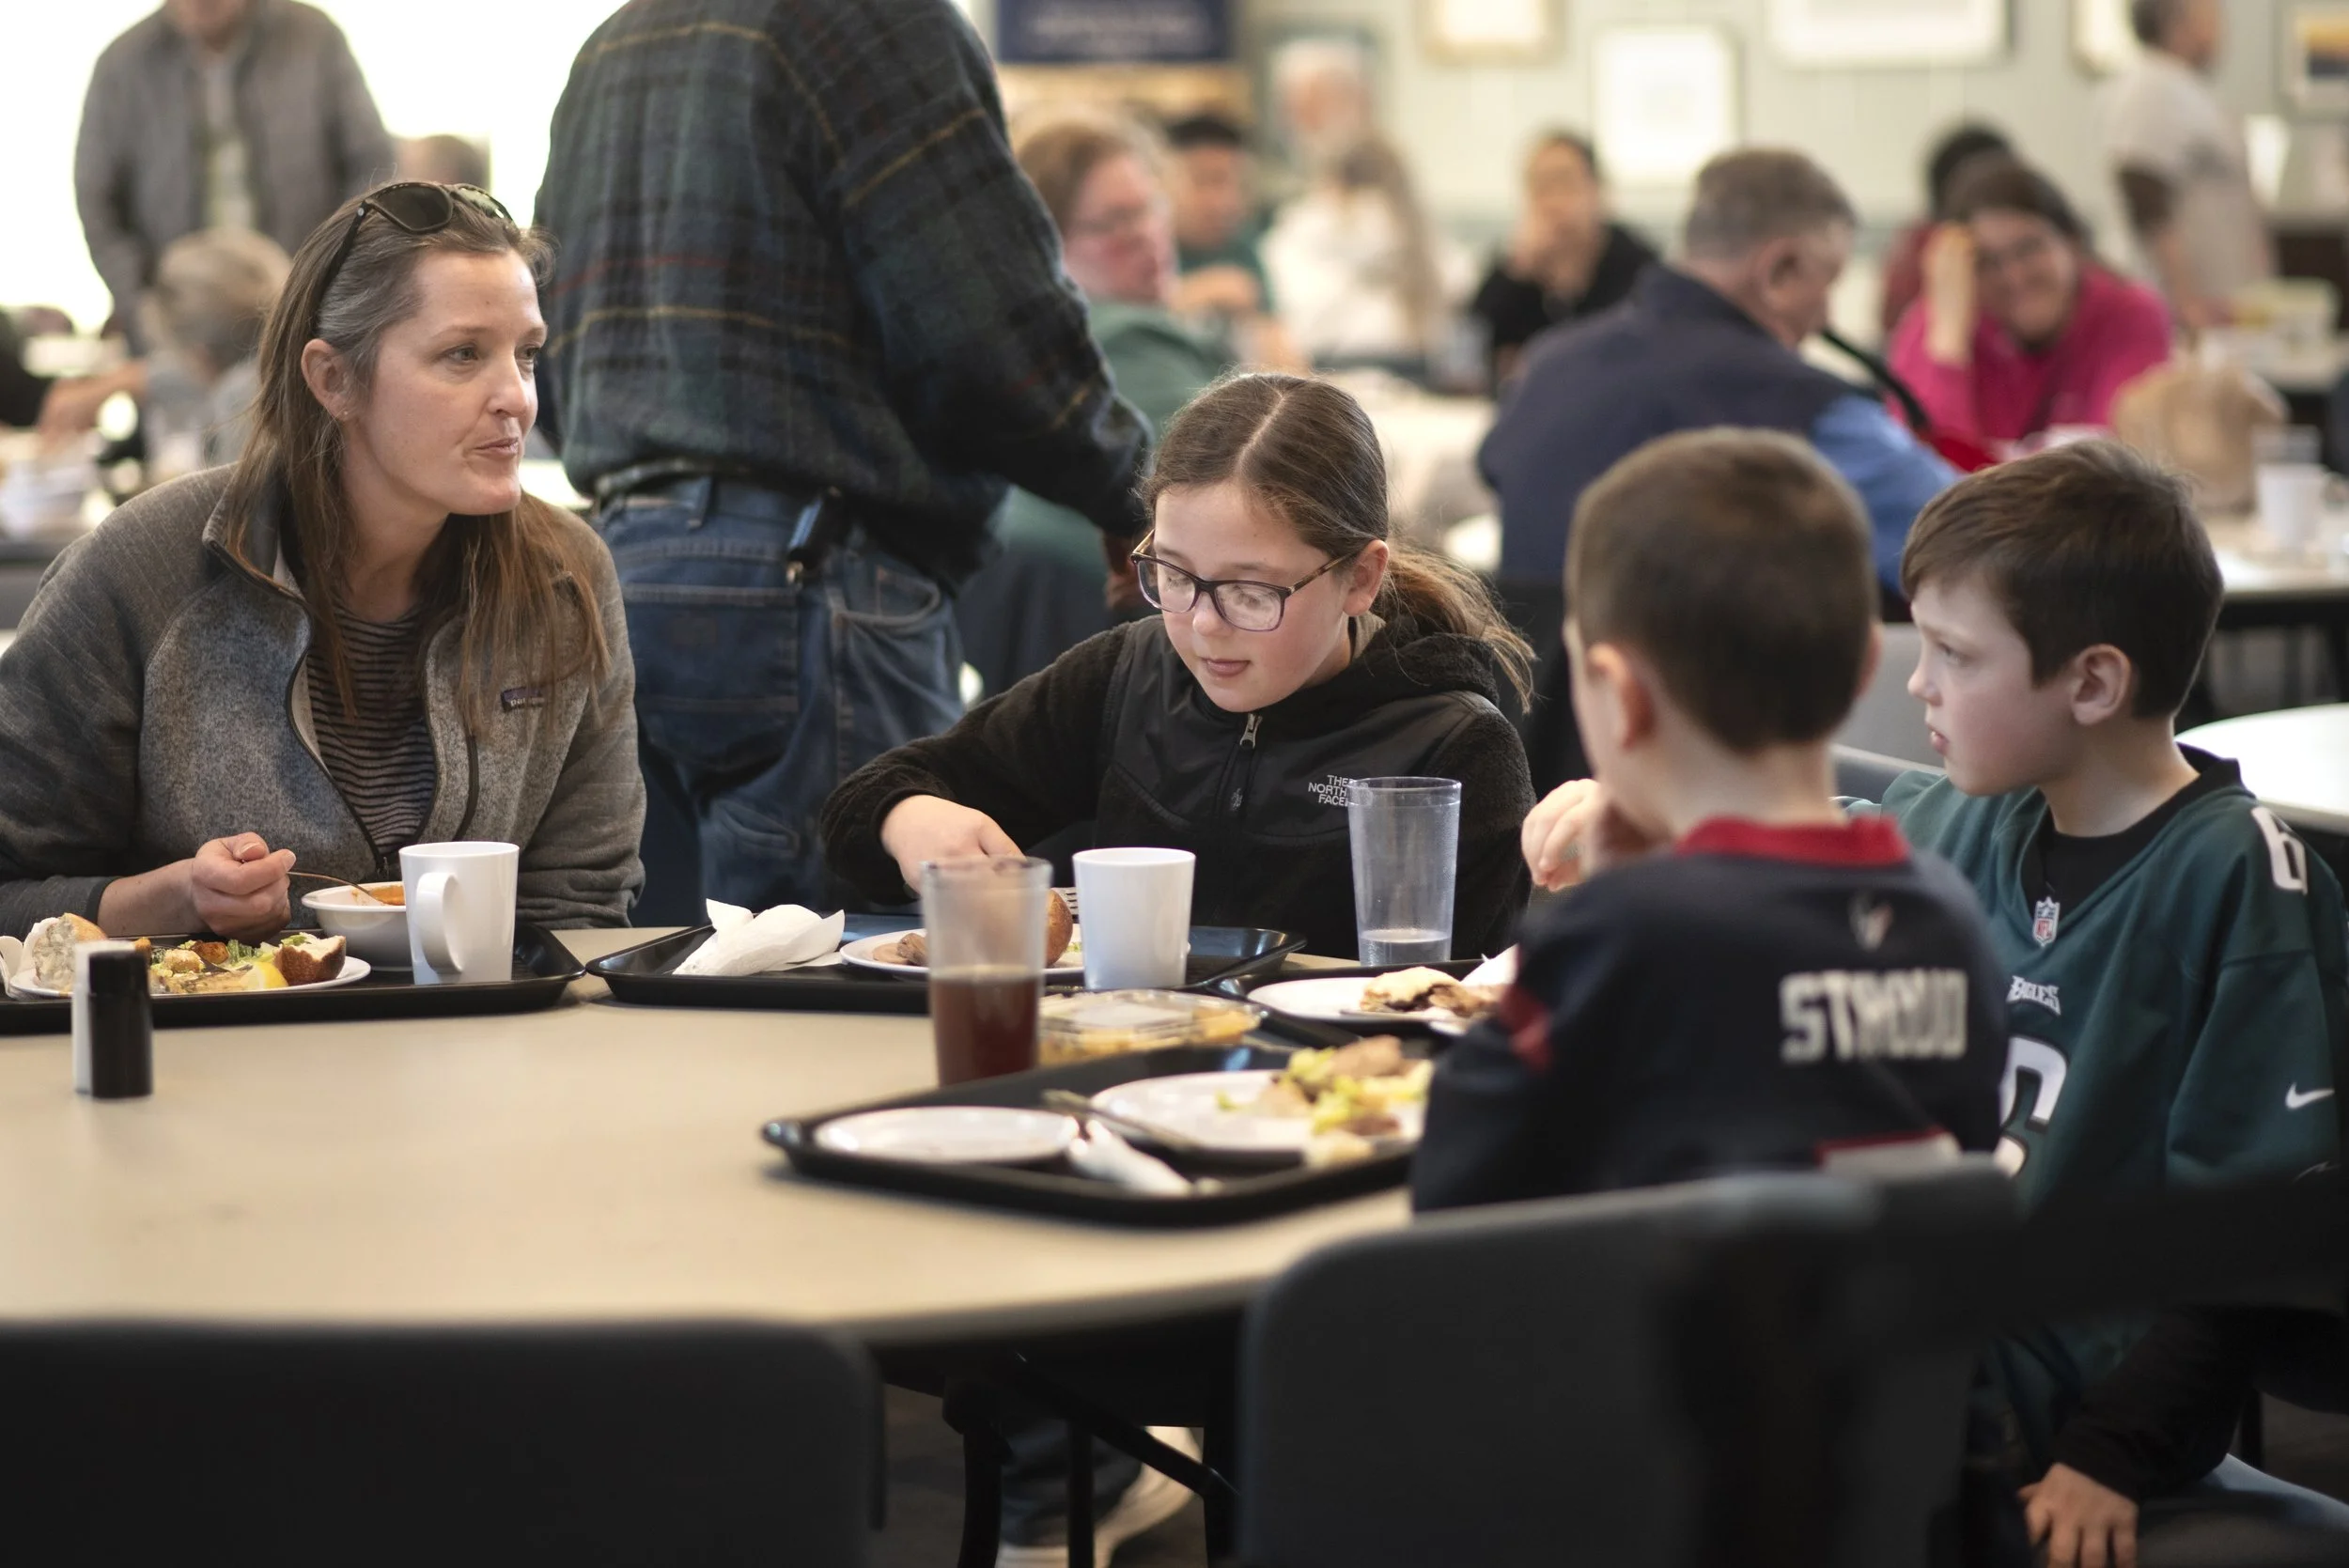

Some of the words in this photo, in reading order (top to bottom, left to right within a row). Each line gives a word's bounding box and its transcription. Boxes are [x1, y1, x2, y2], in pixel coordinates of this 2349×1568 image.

[1327, 774, 1348, 787] THE
[1308, 782, 1346, 797] NORTH
[1318, 793, 1346, 806] FACE
